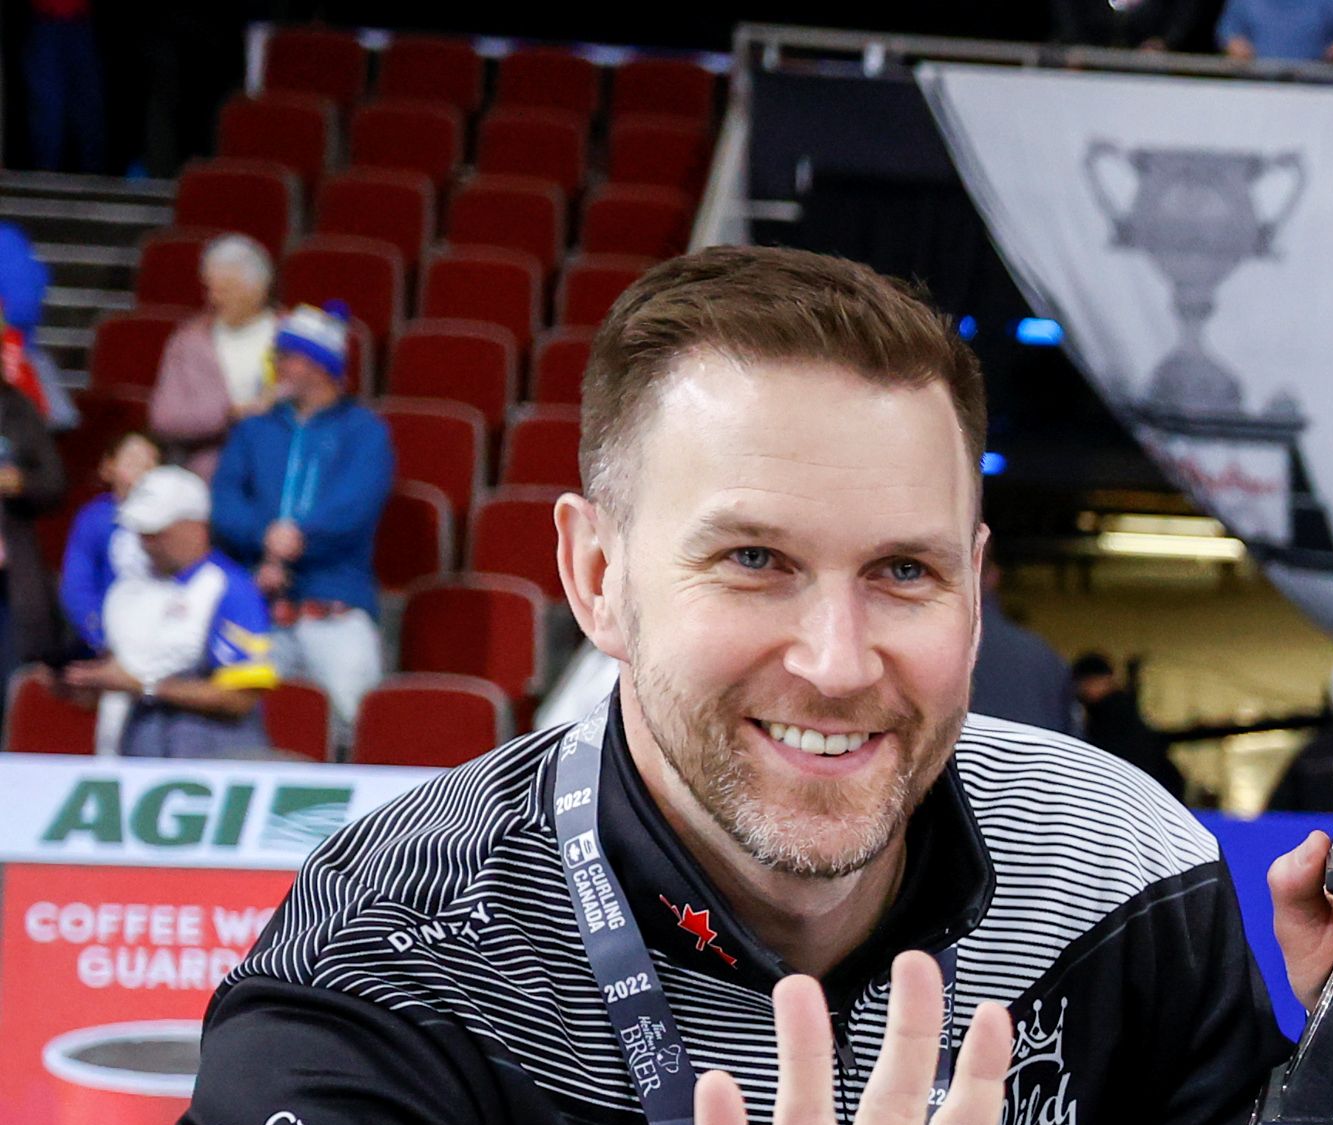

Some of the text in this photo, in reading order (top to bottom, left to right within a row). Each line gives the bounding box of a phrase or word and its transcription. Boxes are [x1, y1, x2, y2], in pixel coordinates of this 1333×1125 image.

[41, 779, 257, 846] AGI
[555, 787, 592, 816] 2022
[24, 901, 207, 946] COFFEE
[573, 869, 605, 933] CANADA
[588, 863, 625, 930] CURLING
[77, 947, 246, 989] GUARD
[604, 972, 651, 1003] 2022
[620, 1024, 661, 1098] BRIER
